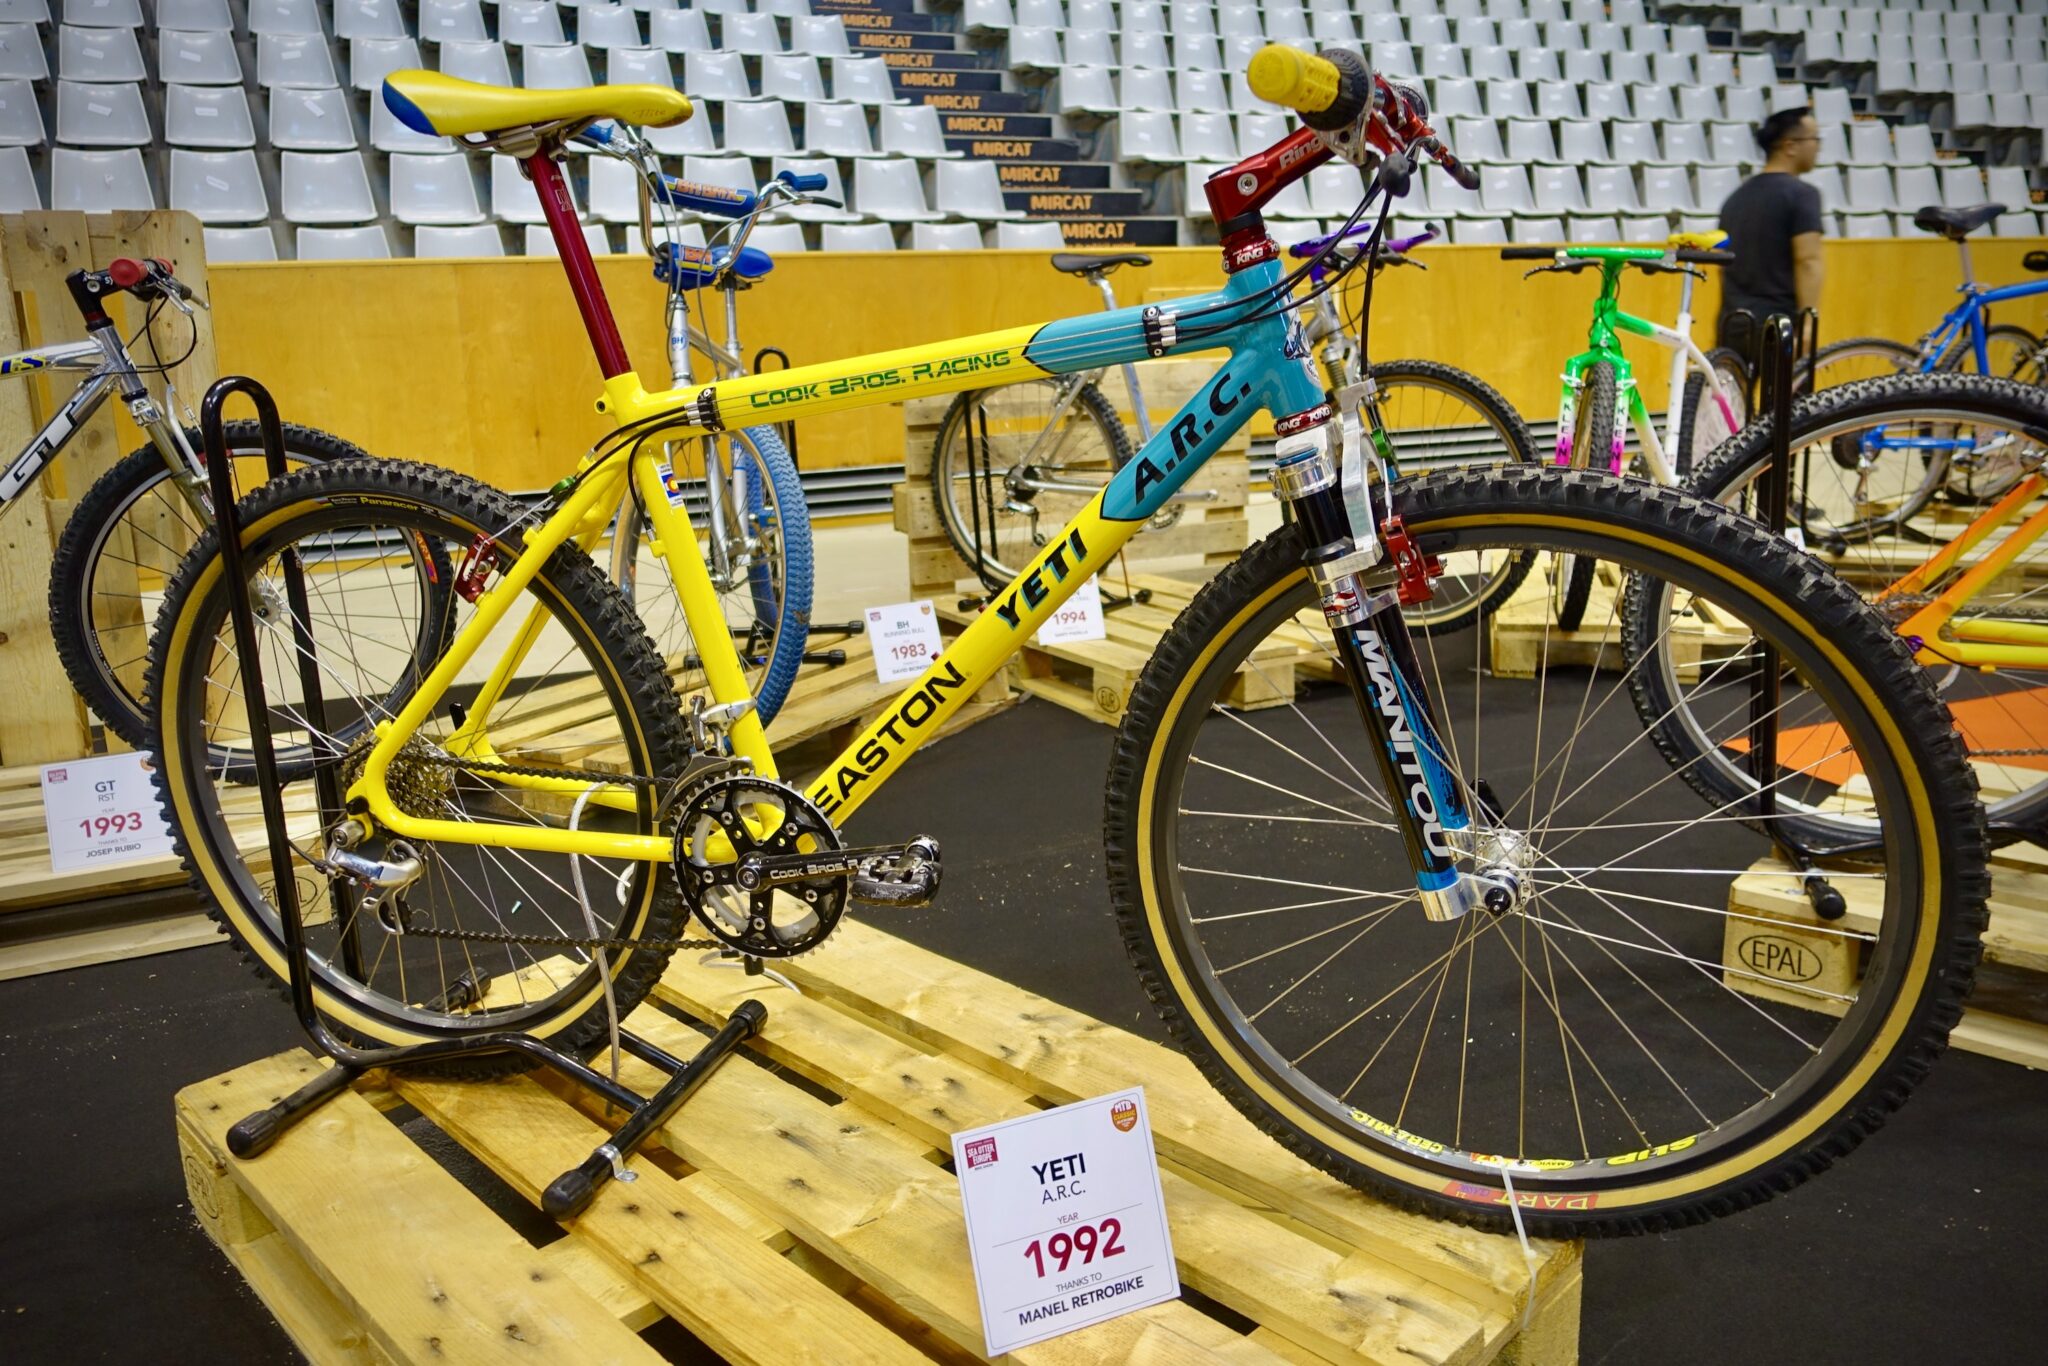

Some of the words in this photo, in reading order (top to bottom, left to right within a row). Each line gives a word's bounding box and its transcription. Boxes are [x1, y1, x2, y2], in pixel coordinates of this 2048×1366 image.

[841, 14, 893, 28] MIRCAT
[859, 34, 912, 48] MIRCAT
[881, 53, 934, 67] MIRCAT
[901, 72, 957, 87] MIRCAT
[924, 95, 981, 109] MIRCAT
[947, 117, 1005, 132] MIRCAT
[973, 142, 1032, 156] MIRCAT
[1000, 166, 1061, 182] MIRCAT
[1030, 195, 1092, 210] MIRCAT
[1062, 222, 1126, 239] MIRCAT
[1236, 248, 1264, 265] KING
[671, 336, 684, 346] BH
[750, 383, 821, 409] COOK
[913, 350, 1011, 382] RACING
[1308, 405, 1331, 422] KING
[1277, 419, 1301, 433] KING
[1558, 403, 1572, 457] KLEIN
[1611, 407, 1625, 459] KLEIN
[1134, 372, 1252, 505] A.R.C.
[360, 496, 419, 511] Panaracer
[996, 527, 1089, 632] YETI
[896, 620, 910, 630] BH
[1053, 611, 1087, 625] 1994
[891, 643, 927, 660] 1983
[811, 660, 967, 817] EASTON
[1355, 629, 1450, 858] MANITOU
[95, 780, 116, 793] GT
[98, 793, 116, 802] RST
[79, 812, 143, 838] 1993
[86, 847, 113, 858] JOSEP
[114, 842, 142, 853] RUBIO
[1752, 940, 1808, 978] EPAL
[1114, 1100, 1132, 1113] MTB
[1350, 1107, 1444, 1154] CERAMIC
[977, 1143, 995, 1155] OTTER
[1031, 1152, 1087, 1185] YETI
[1042, 1180, 1087, 1205] A.R.C.
[1057, 1212, 1079, 1225] YEAR
[1024, 1217, 1126, 1279] 1992
[1056, 1275, 1089, 1293] THANKS
[1090, 1272, 1103, 1283] TO
[1018, 1301, 1069, 1326] MANEL
[1071, 1275, 1144, 1309] RETROBIKE
